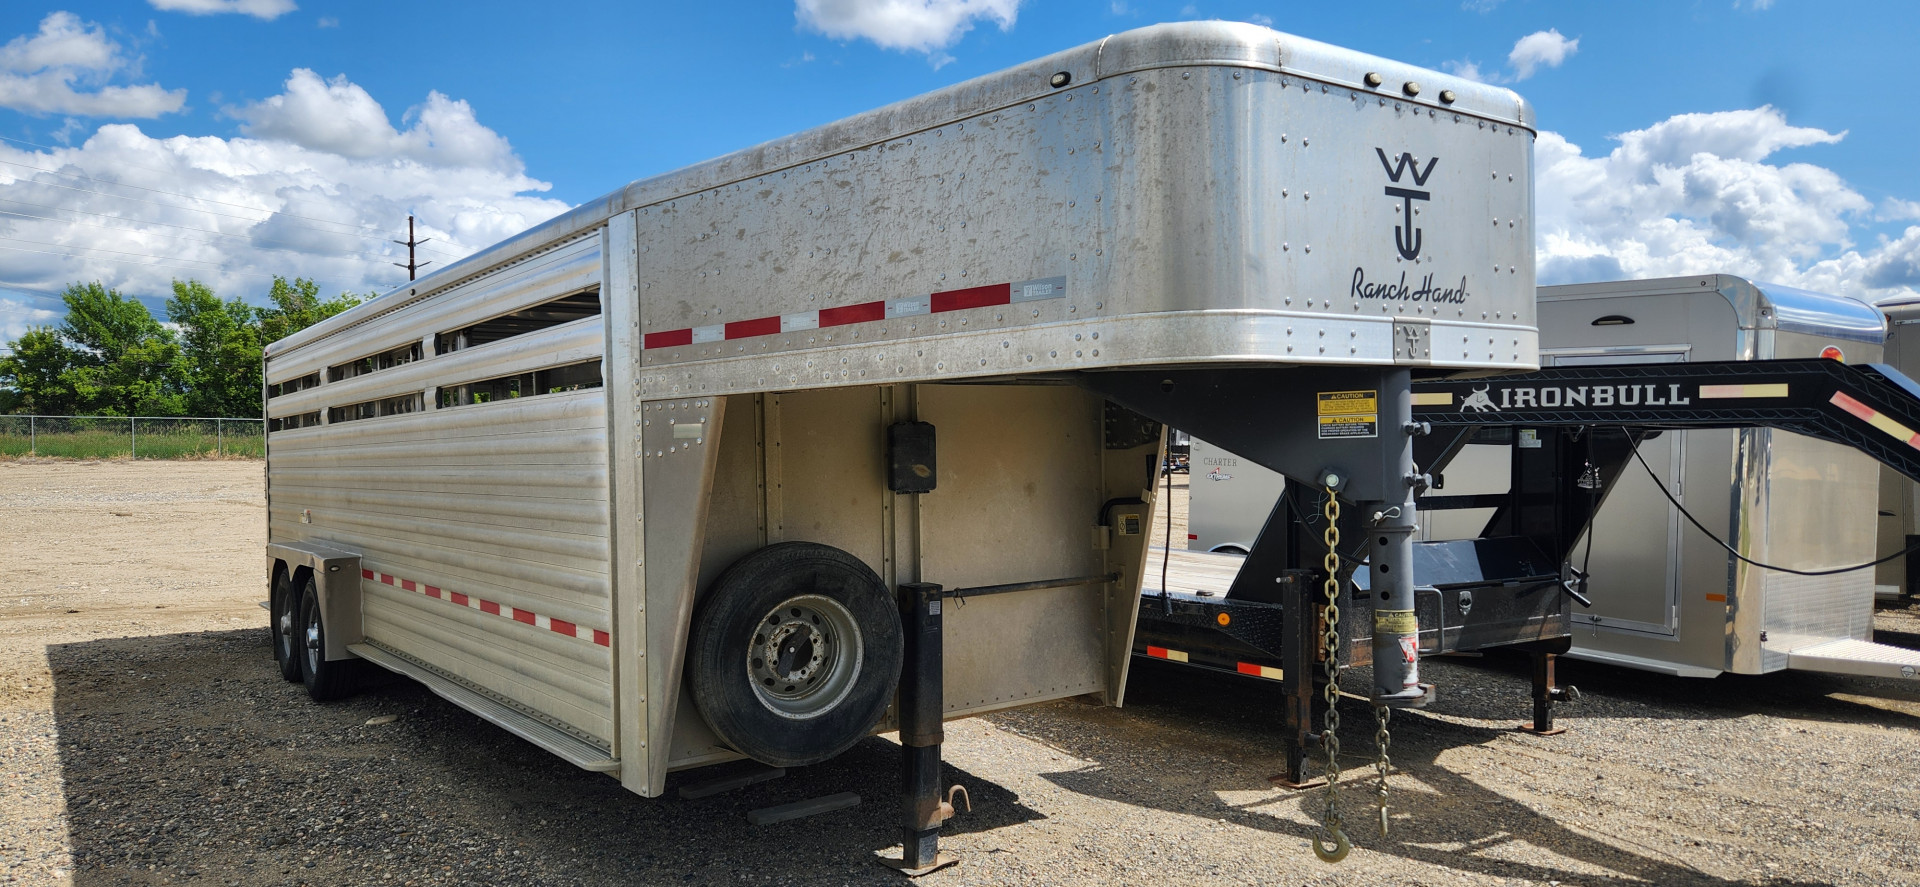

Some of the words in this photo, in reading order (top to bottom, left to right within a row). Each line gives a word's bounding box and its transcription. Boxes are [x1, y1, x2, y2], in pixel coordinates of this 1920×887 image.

[1351, 266, 1410, 301] Ranch
[1412, 272, 1467, 304] Hand
[1500, 383, 1690, 408] IRONBULL
[1203, 457, 1237, 467] CHARTER
